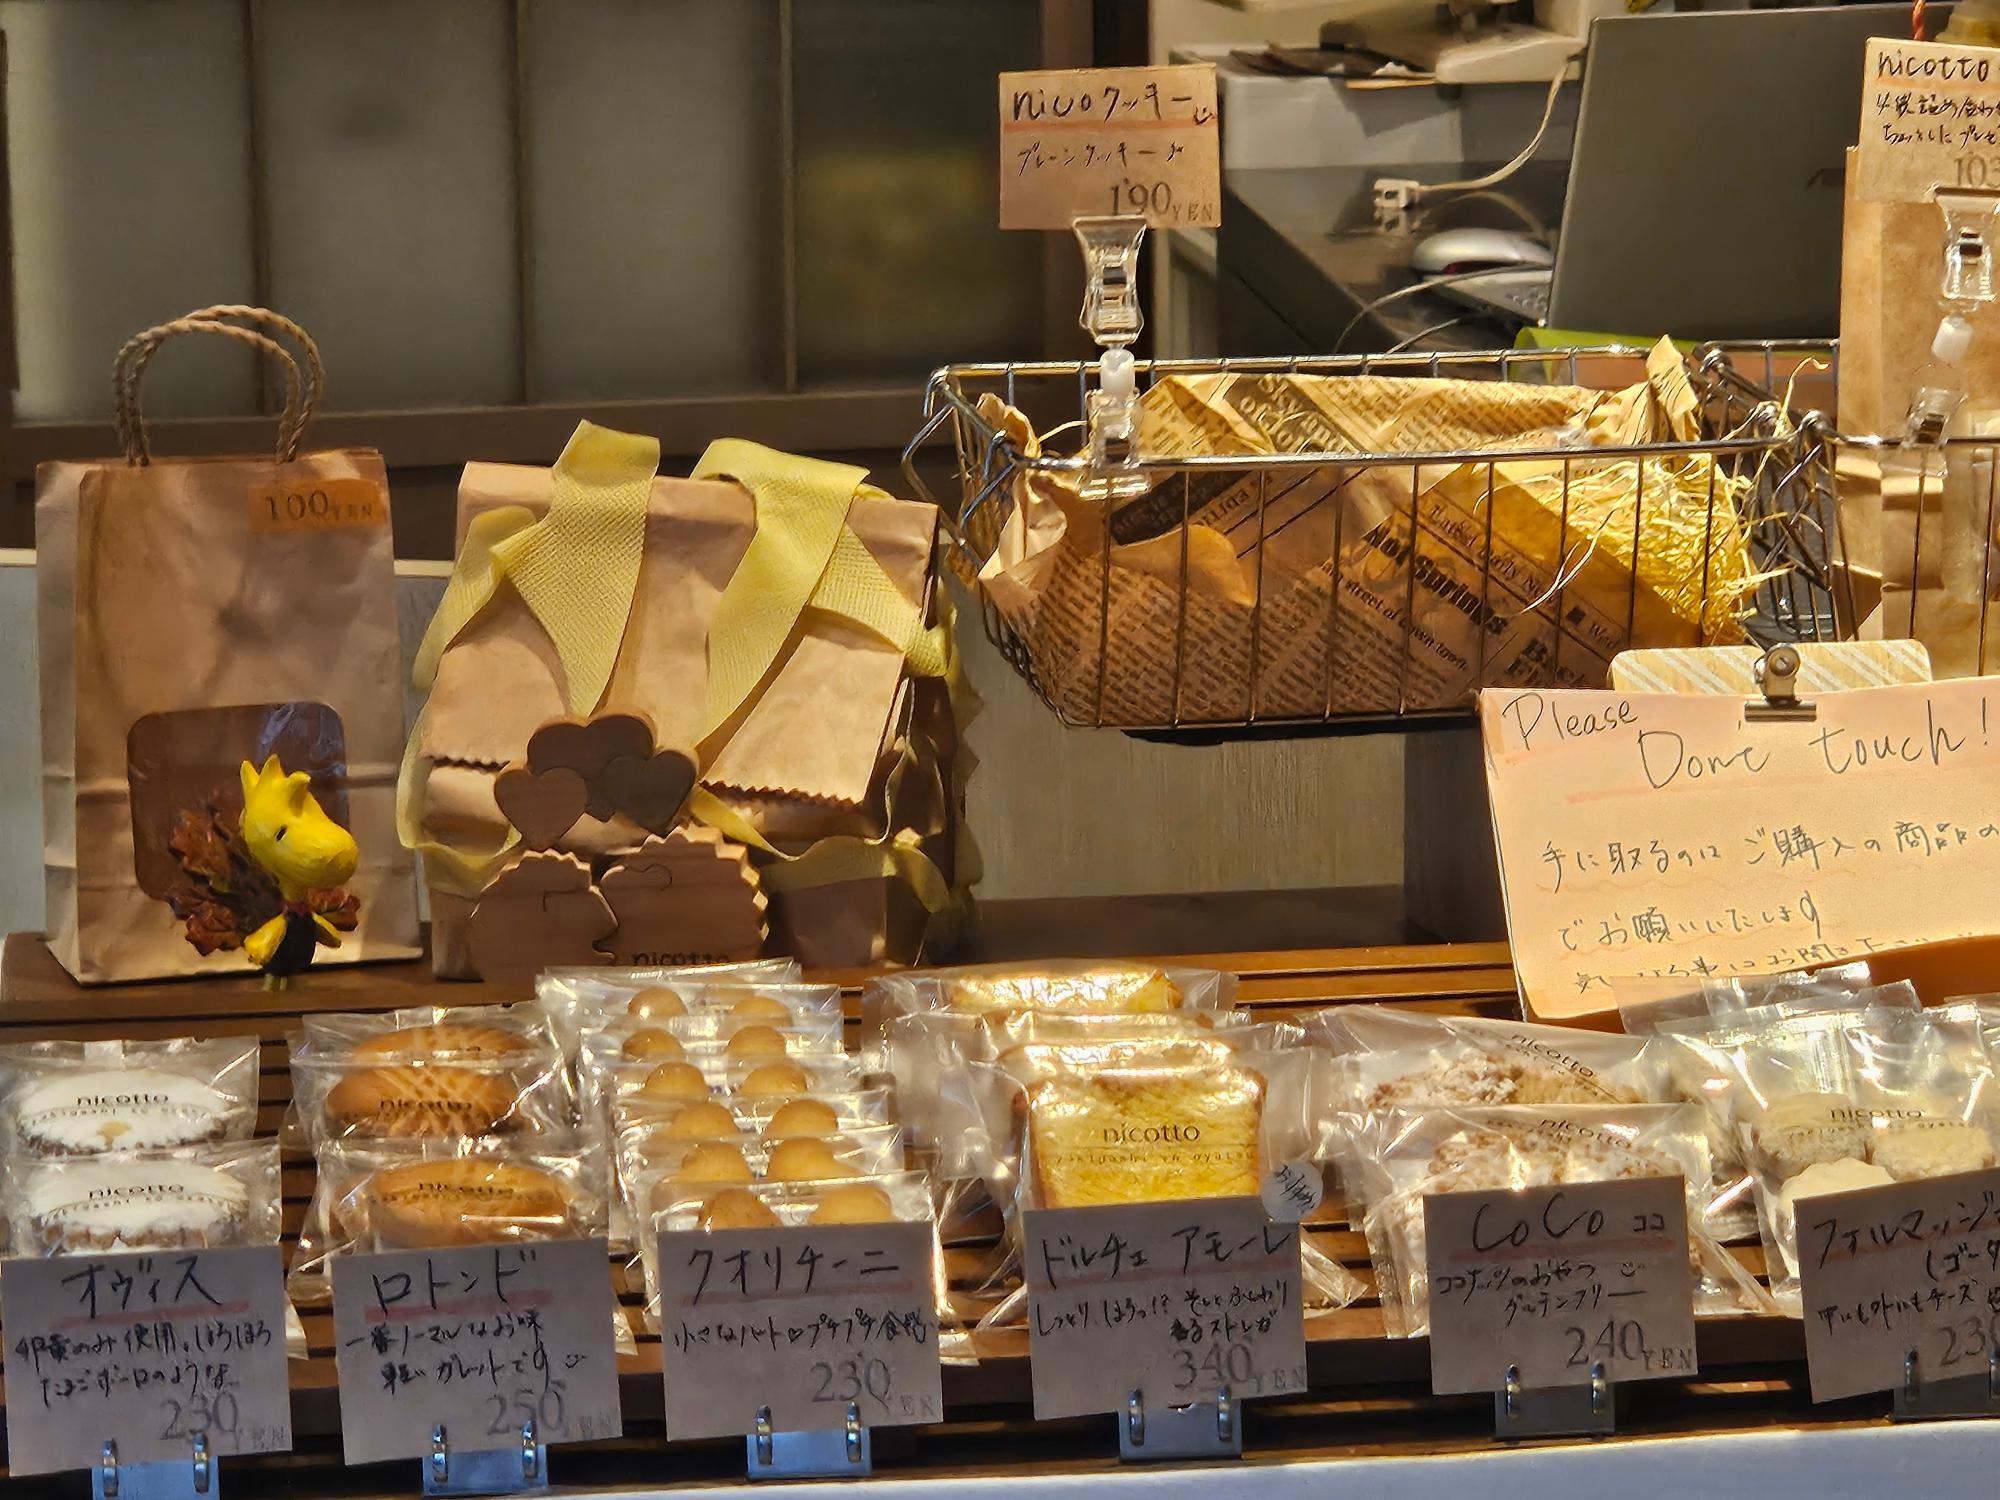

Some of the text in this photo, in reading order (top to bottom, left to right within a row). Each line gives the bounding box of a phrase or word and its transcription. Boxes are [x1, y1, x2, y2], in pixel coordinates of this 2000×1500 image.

[1878, 50, 1989, 82] nicotto
[1110, 181, 1172, 216] 190
[265, 488, 328, 520] 100
[1502, 693, 1638, 751] Please
[77, 1093, 170, 1107] nicotto
[1102, 1121, 1201, 1144] nicotto
[1564, 1319, 1645, 1369] 240
[810, 1357, 892, 1404] 230
